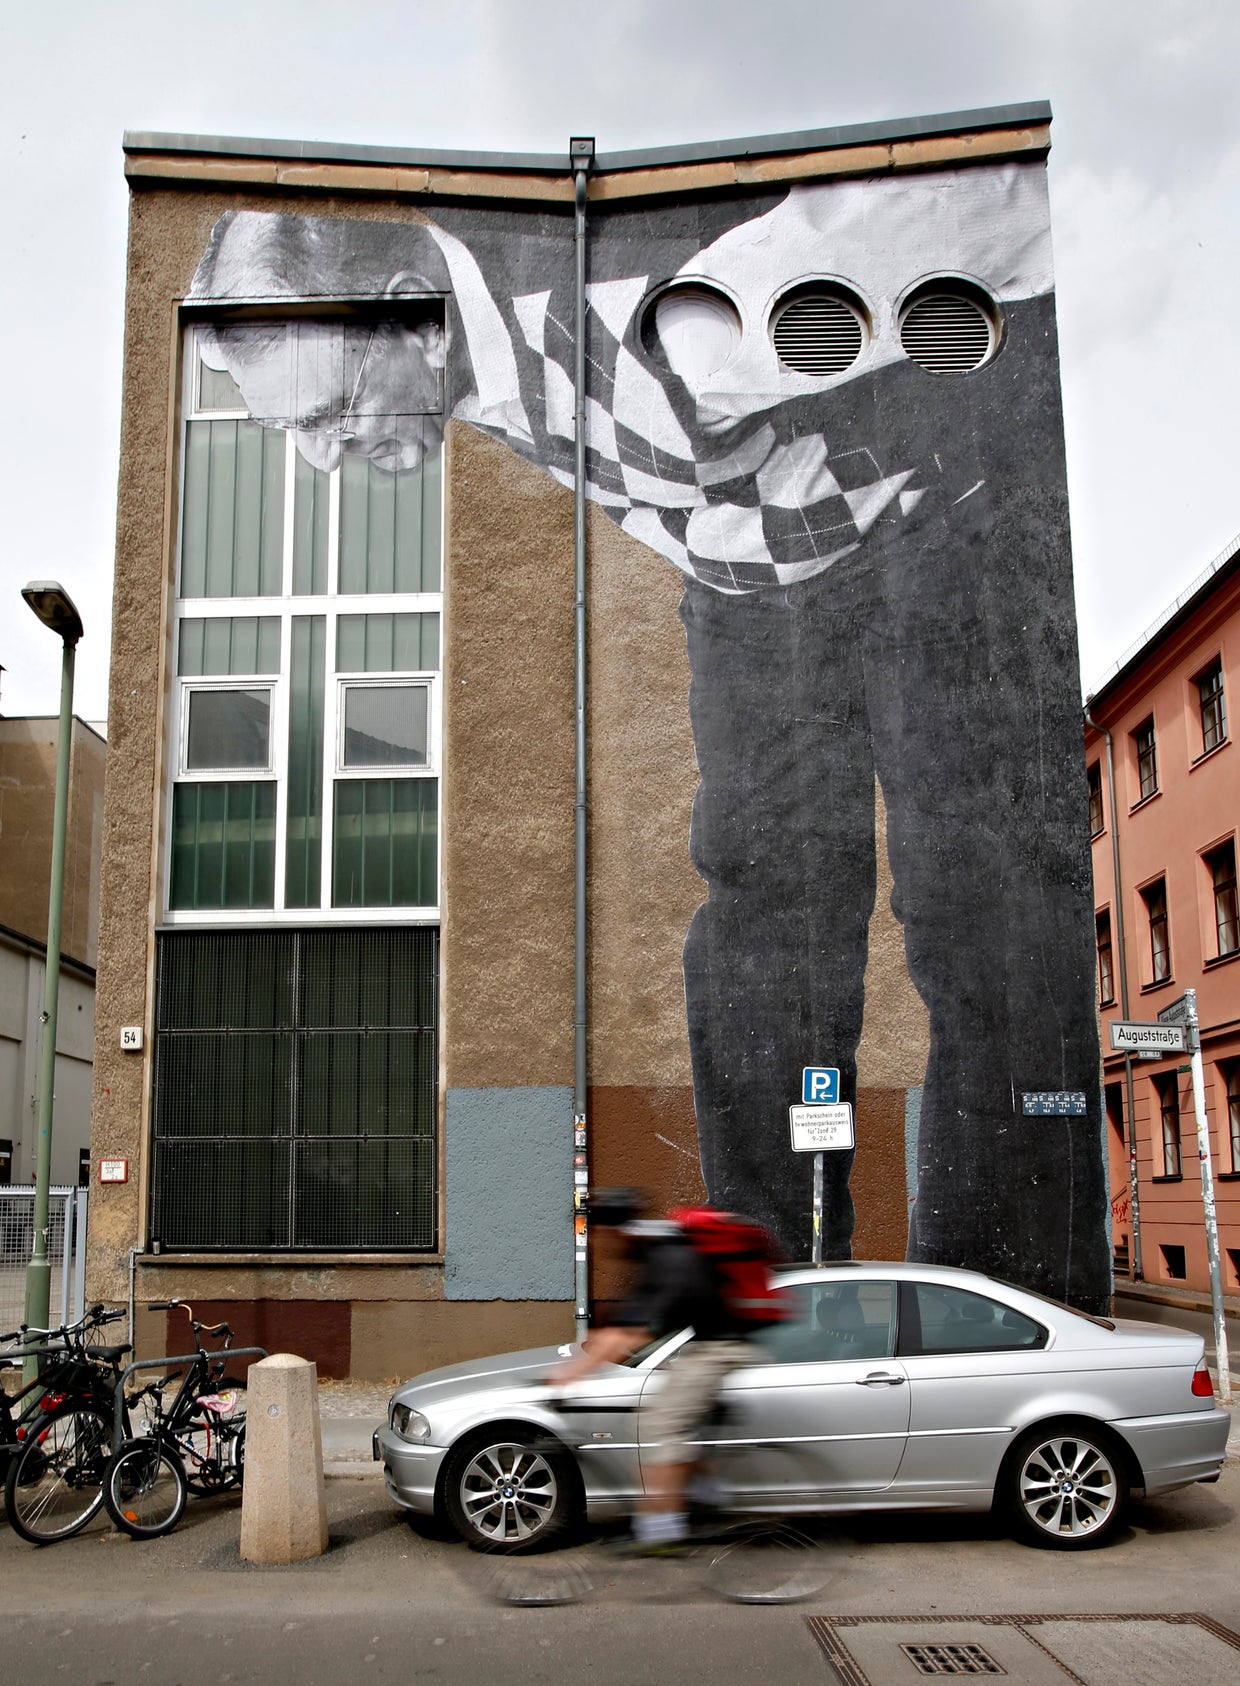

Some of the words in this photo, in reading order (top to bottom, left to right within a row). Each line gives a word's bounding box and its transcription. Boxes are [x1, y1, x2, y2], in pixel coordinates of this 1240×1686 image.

[123, 1031, 136, 1044] 54
[1117, 1027, 1180, 1045] Auguststraße
[811, 1072, 831, 1100] P
